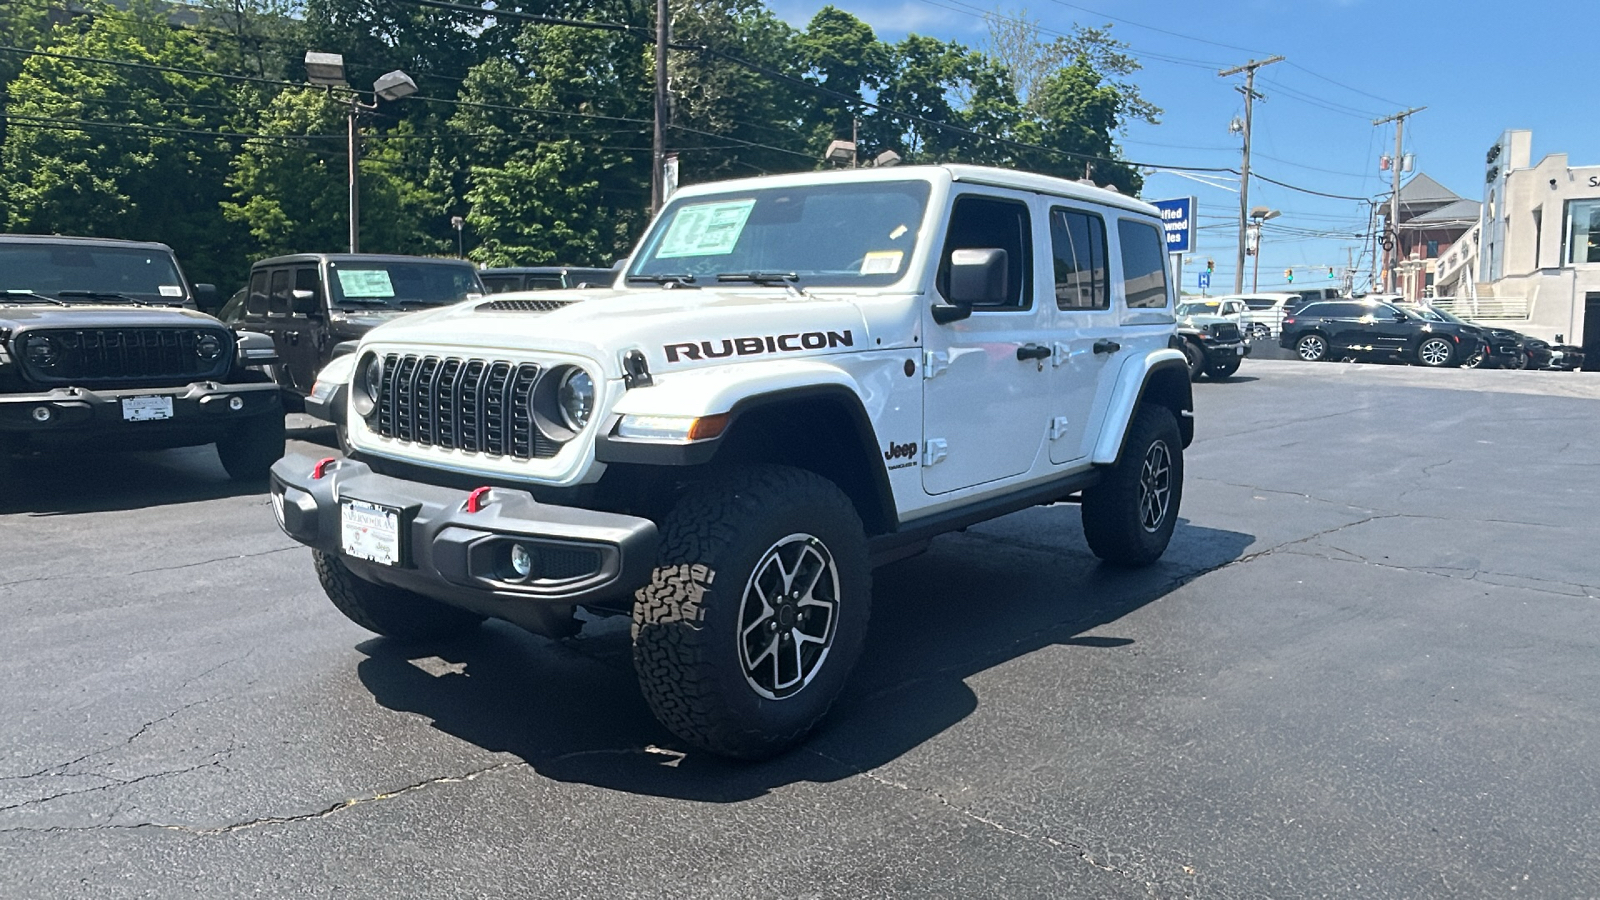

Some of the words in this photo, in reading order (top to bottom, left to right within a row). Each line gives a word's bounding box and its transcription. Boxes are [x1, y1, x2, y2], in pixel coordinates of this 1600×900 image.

[1589, 176, 1600, 188] S
[664, 330, 853, 362] RUBICON
[885, 441, 917, 460] Jeep
